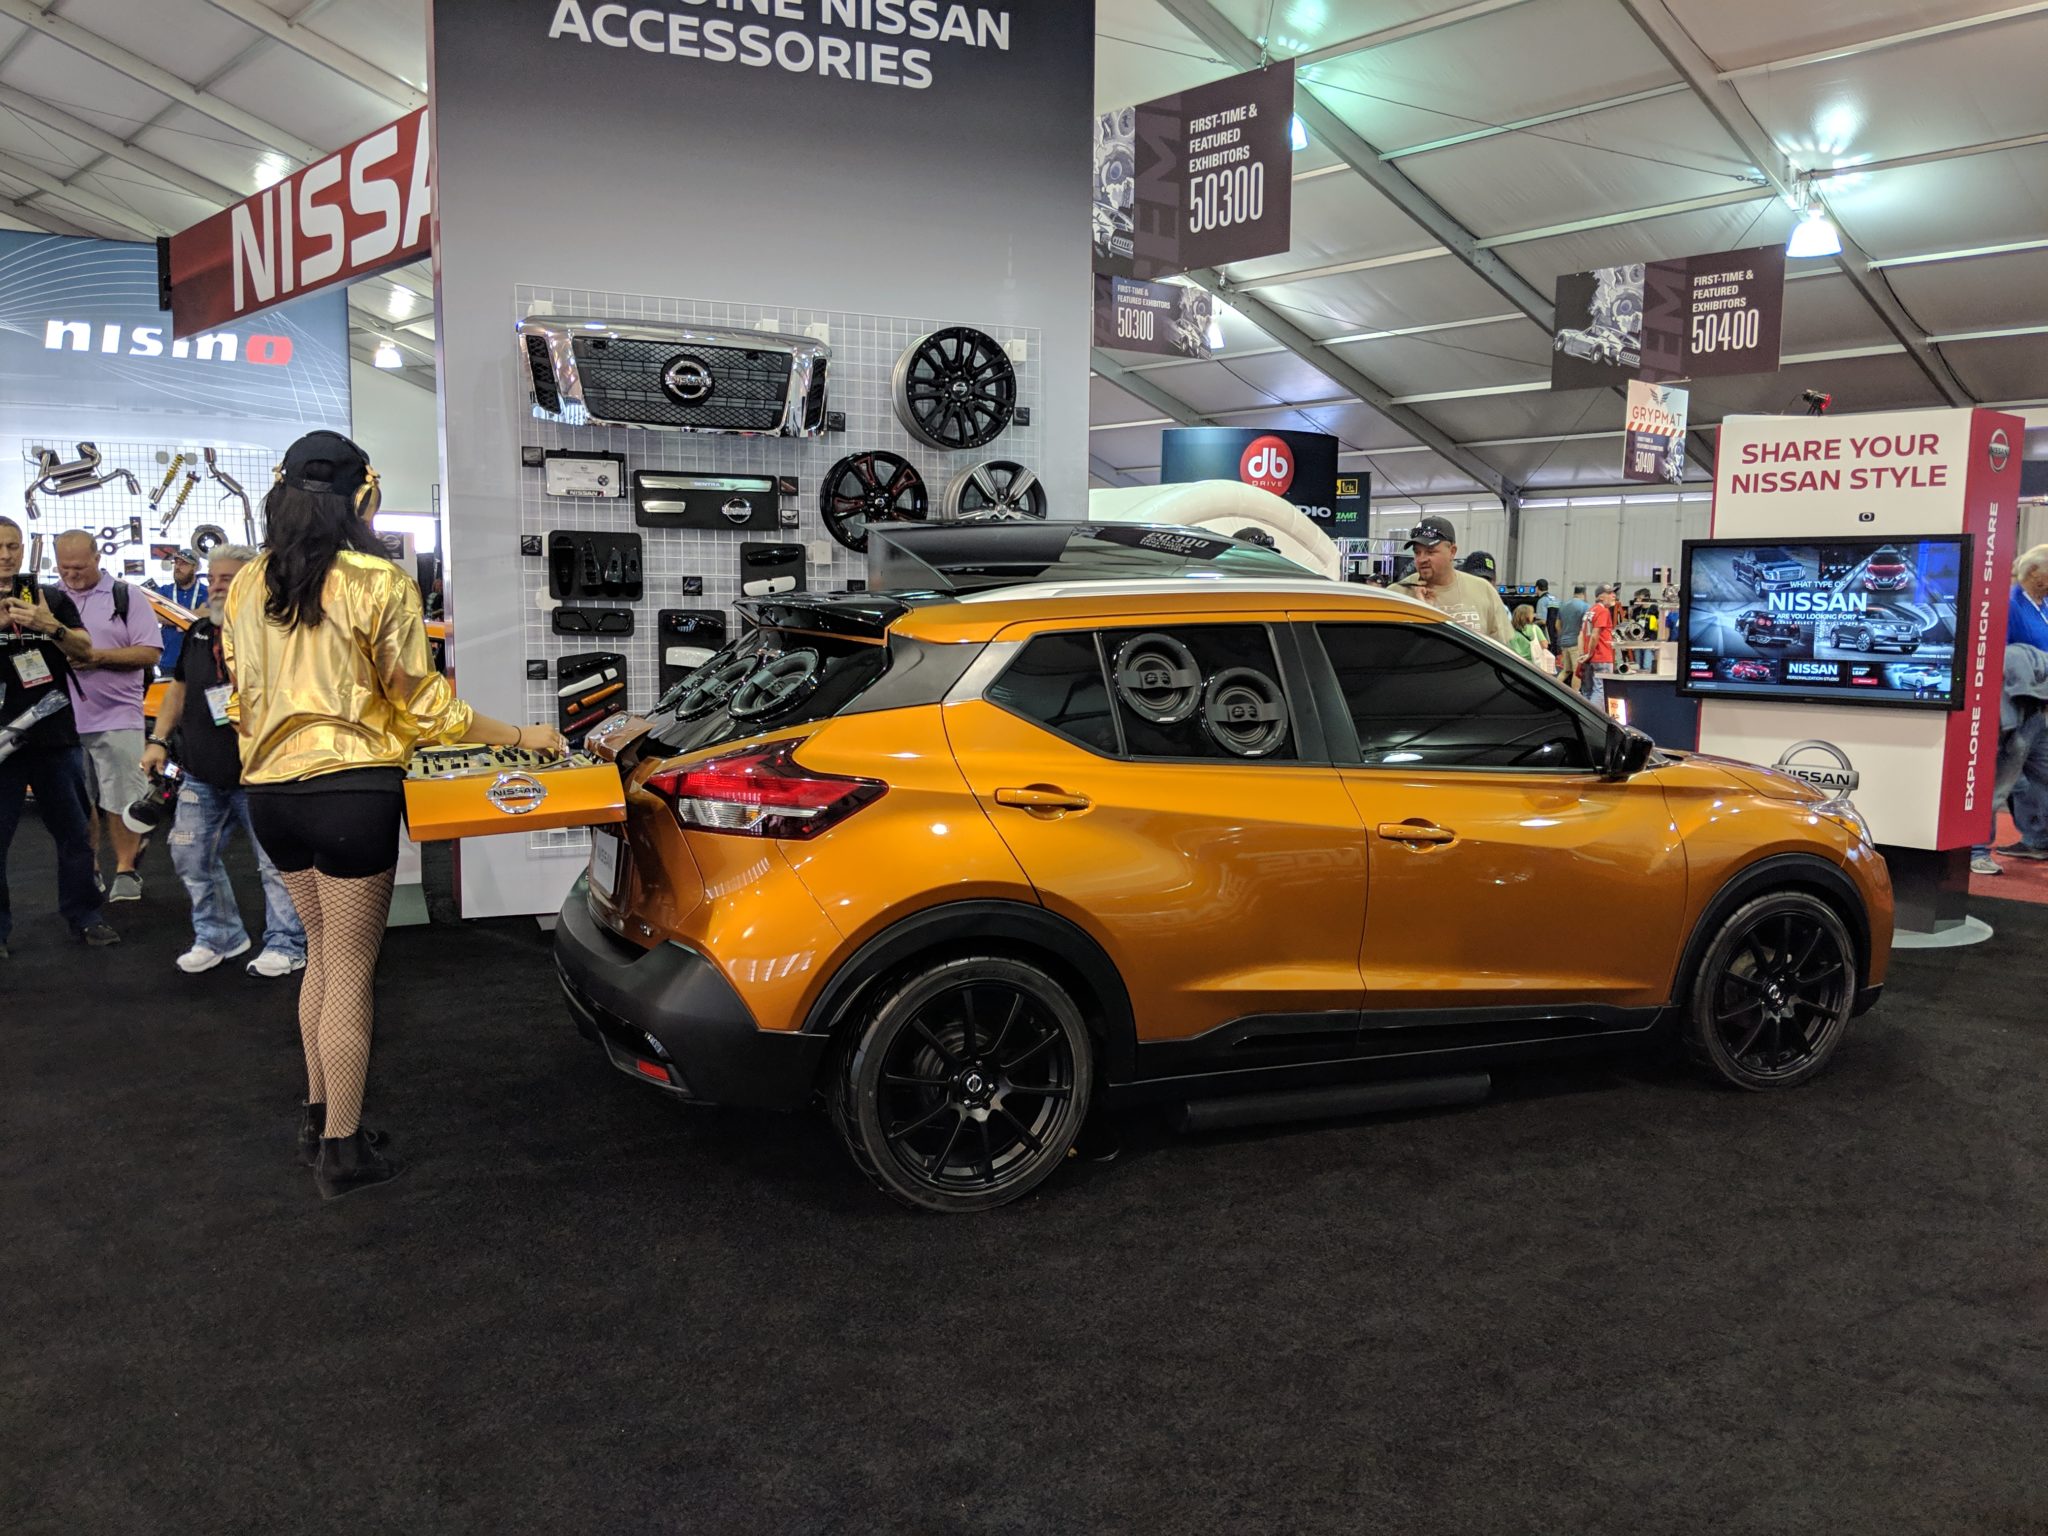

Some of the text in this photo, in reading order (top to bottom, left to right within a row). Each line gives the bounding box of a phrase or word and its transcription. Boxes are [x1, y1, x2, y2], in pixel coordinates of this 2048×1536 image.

[821, 0, 1010, 50] NISSAN
[548, 0, 933, 89] ACCESSORIES
[1190, 103, 1258, 135] FIRST-TIME &
[1189, 127, 1241, 154] FEATURED
[1189, 145, 1250, 173] EXHIBITORS
[1189, 161, 1264, 233] 50300
[1693, 269, 1754, 287] FIRST-TIME &
[1117, 294, 1171, 310] FEATURED EXHIBITORS
[1692, 285, 1739, 300] FEATURED
[1692, 297, 1747, 313] EXHIBITORS
[1117, 306, 1154, 341] 50300
[1691, 308, 1760, 354] 50400
[1632, 405, 1683, 427] GRYPMAT
[1742, 433, 1940, 465] SHARE YOUR
[1247, 447, 1289, 479] db
[1635, 451, 1656, 474] 50400
[1251, 480, 1283, 488] DRIVE
[1731, 464, 1948, 495] NISSAN STYLE
[1790, 580, 1812, 589] WHAT
[1814, 580, 1833, 589] TYPE
[1768, 592, 1868, 613] NISSAN
[1776, 612, 1857, 621] ARE YOU LOOKING FOR?
[1788, 663, 1838, 675] NISSAN
[1965, 706, 1981, 811] EXPLORE
[1974, 601, 1990, 688] DESIGN
[1983, 502, 1998, 582] SHARE
[493, 786, 542, 797] NISSAN
